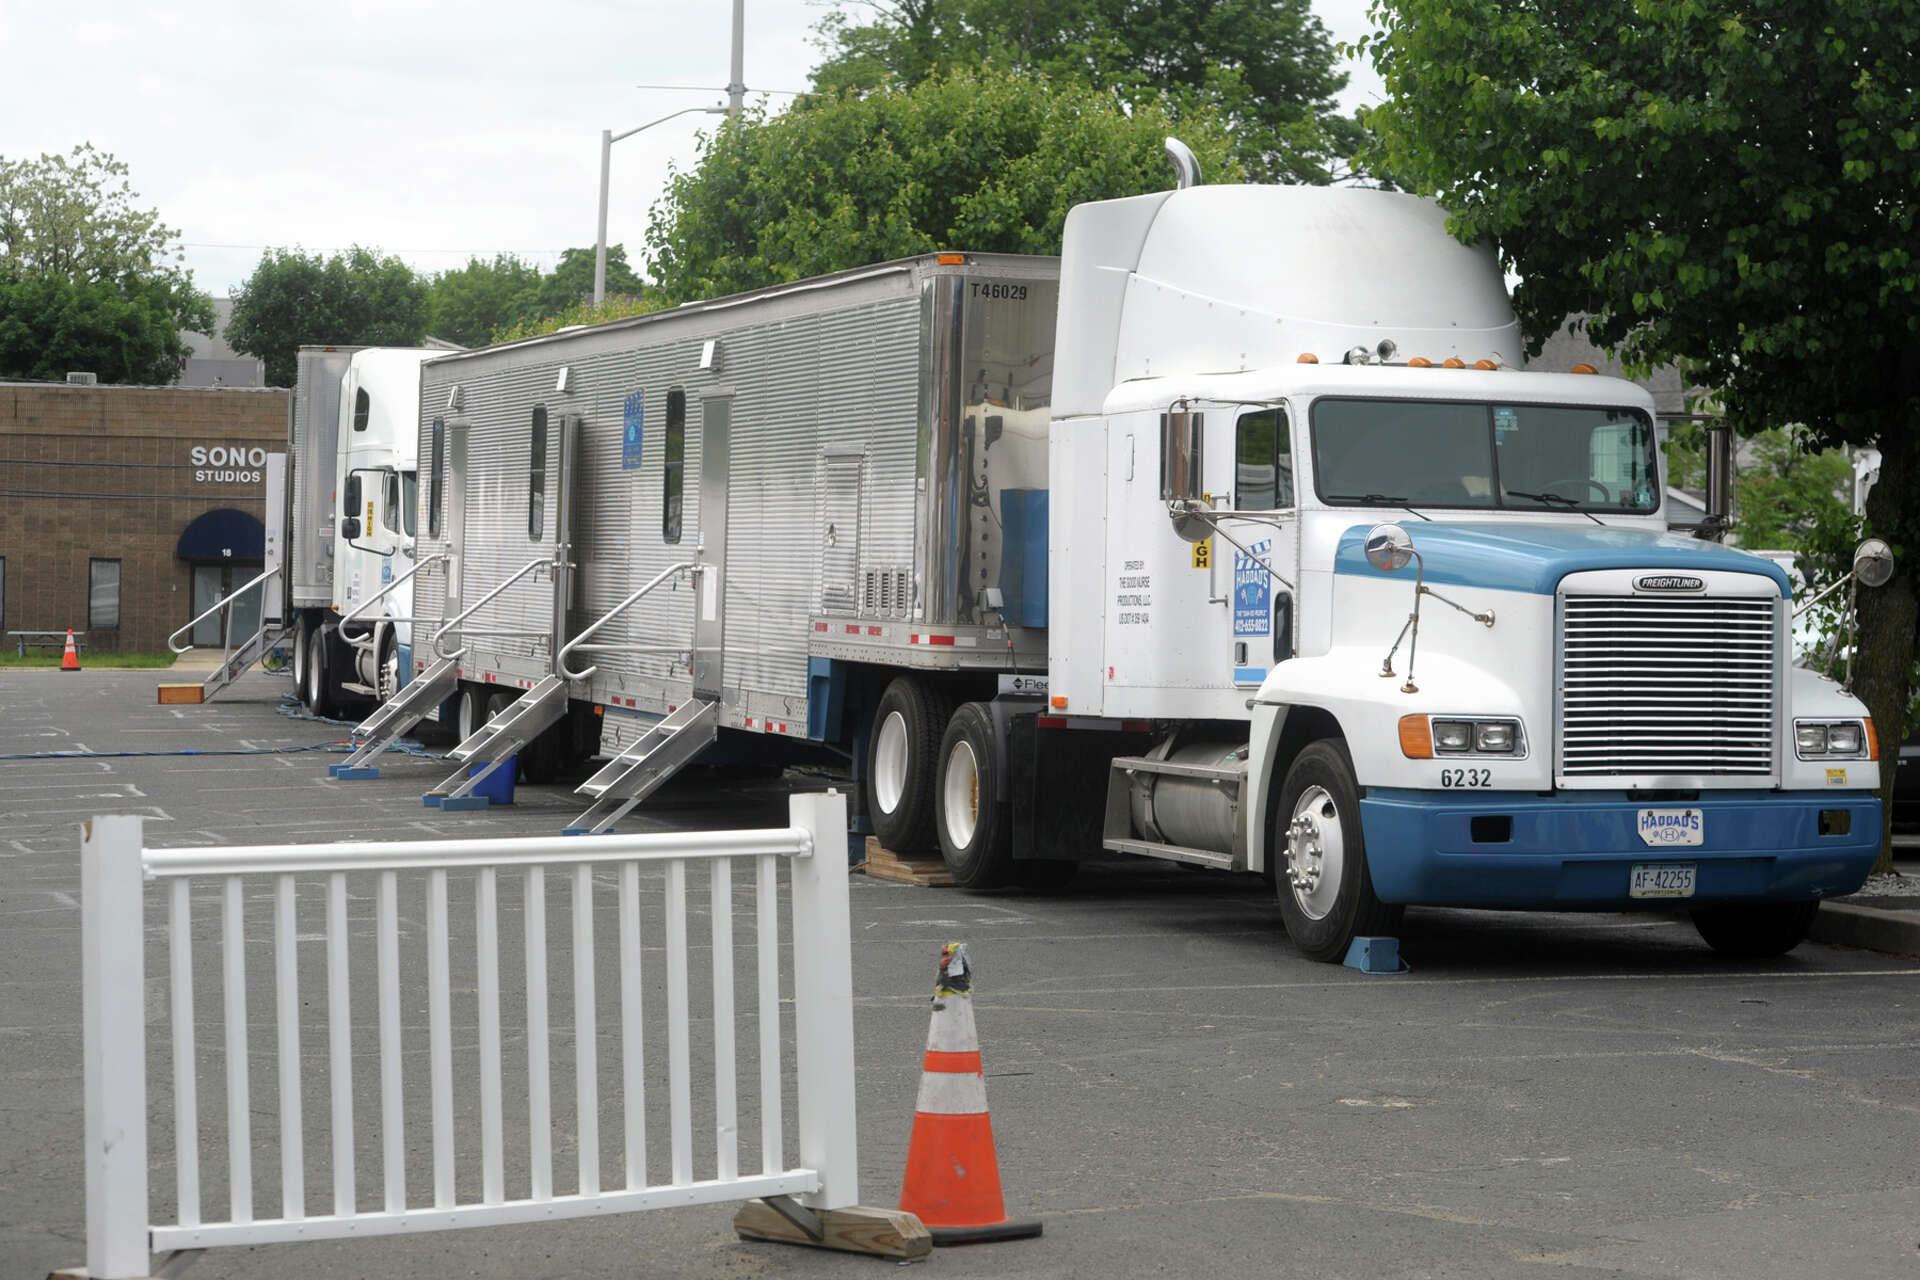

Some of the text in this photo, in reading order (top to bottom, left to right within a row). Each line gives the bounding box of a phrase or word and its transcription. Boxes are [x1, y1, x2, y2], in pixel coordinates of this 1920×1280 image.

[971, 283, 1027, 300] T46029
[191, 446, 266, 467] SONO
[195, 470, 261, 482] STUDIOS
[1641, 577, 1701, 588] FREIGHTLINER
[1441, 769, 1492, 787] 6232
